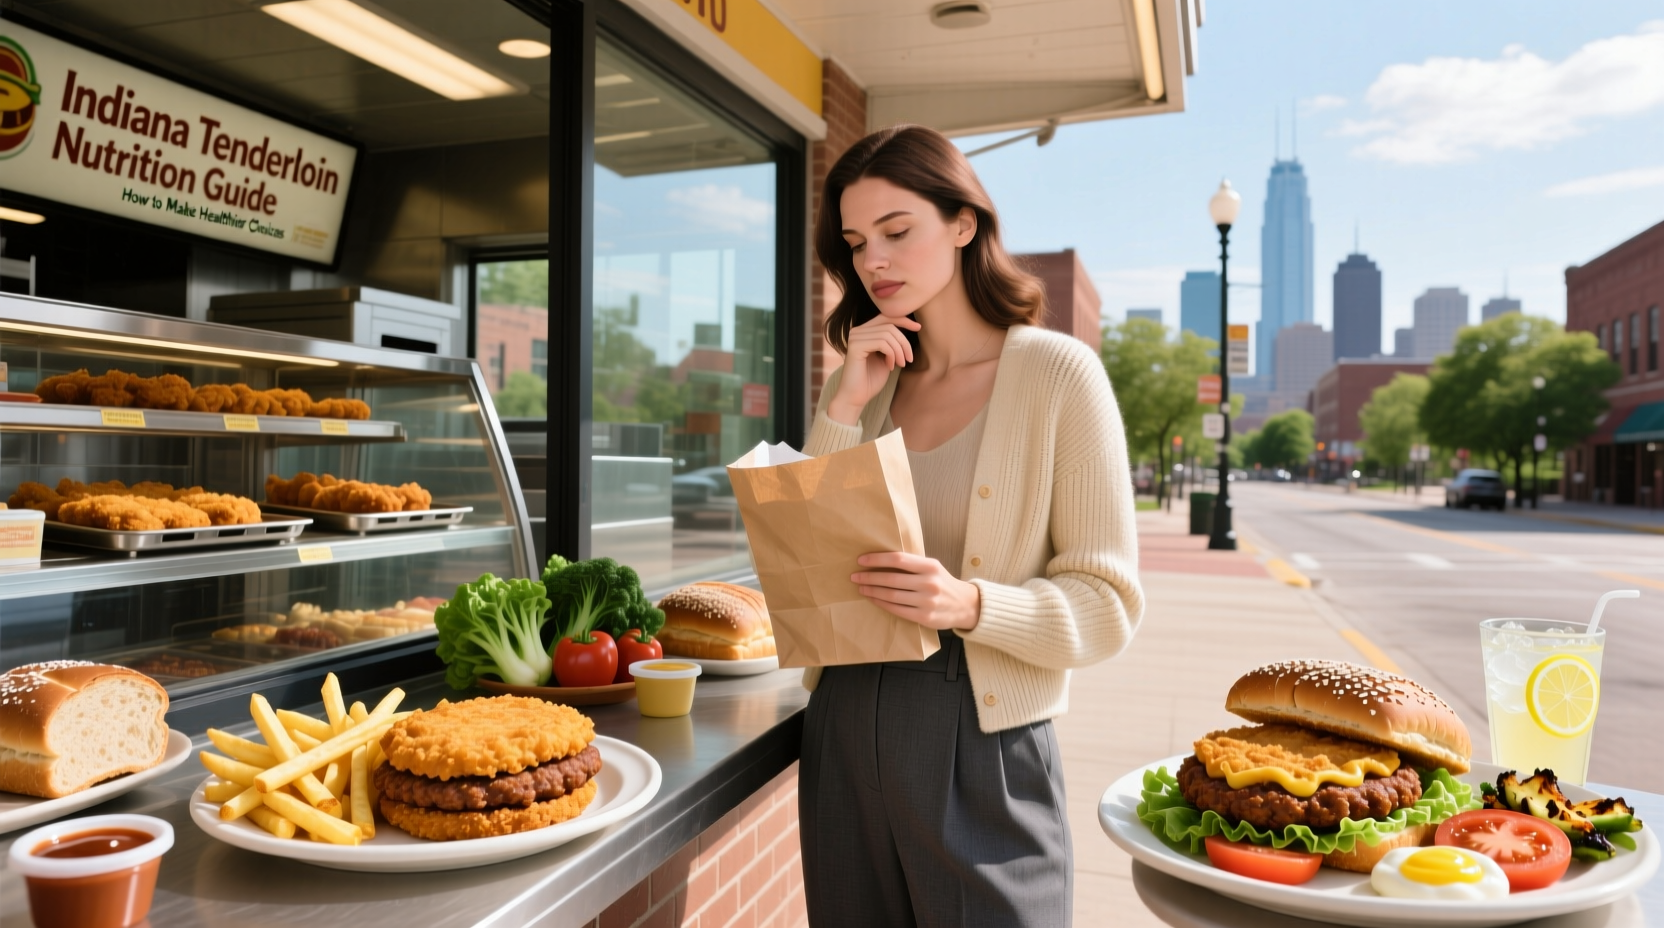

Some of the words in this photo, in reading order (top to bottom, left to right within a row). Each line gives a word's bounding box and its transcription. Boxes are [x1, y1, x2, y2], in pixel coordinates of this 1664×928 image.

[52, 121, 197, 194] Nutrition
[203, 168, 278, 216] Guide
[61, 69, 190, 148] Indiana
[200, 116, 339, 194] Tenderloin
[122, 188, 149, 206] How
[152, 195, 162, 209] to
[166, 197, 197, 218] Make
